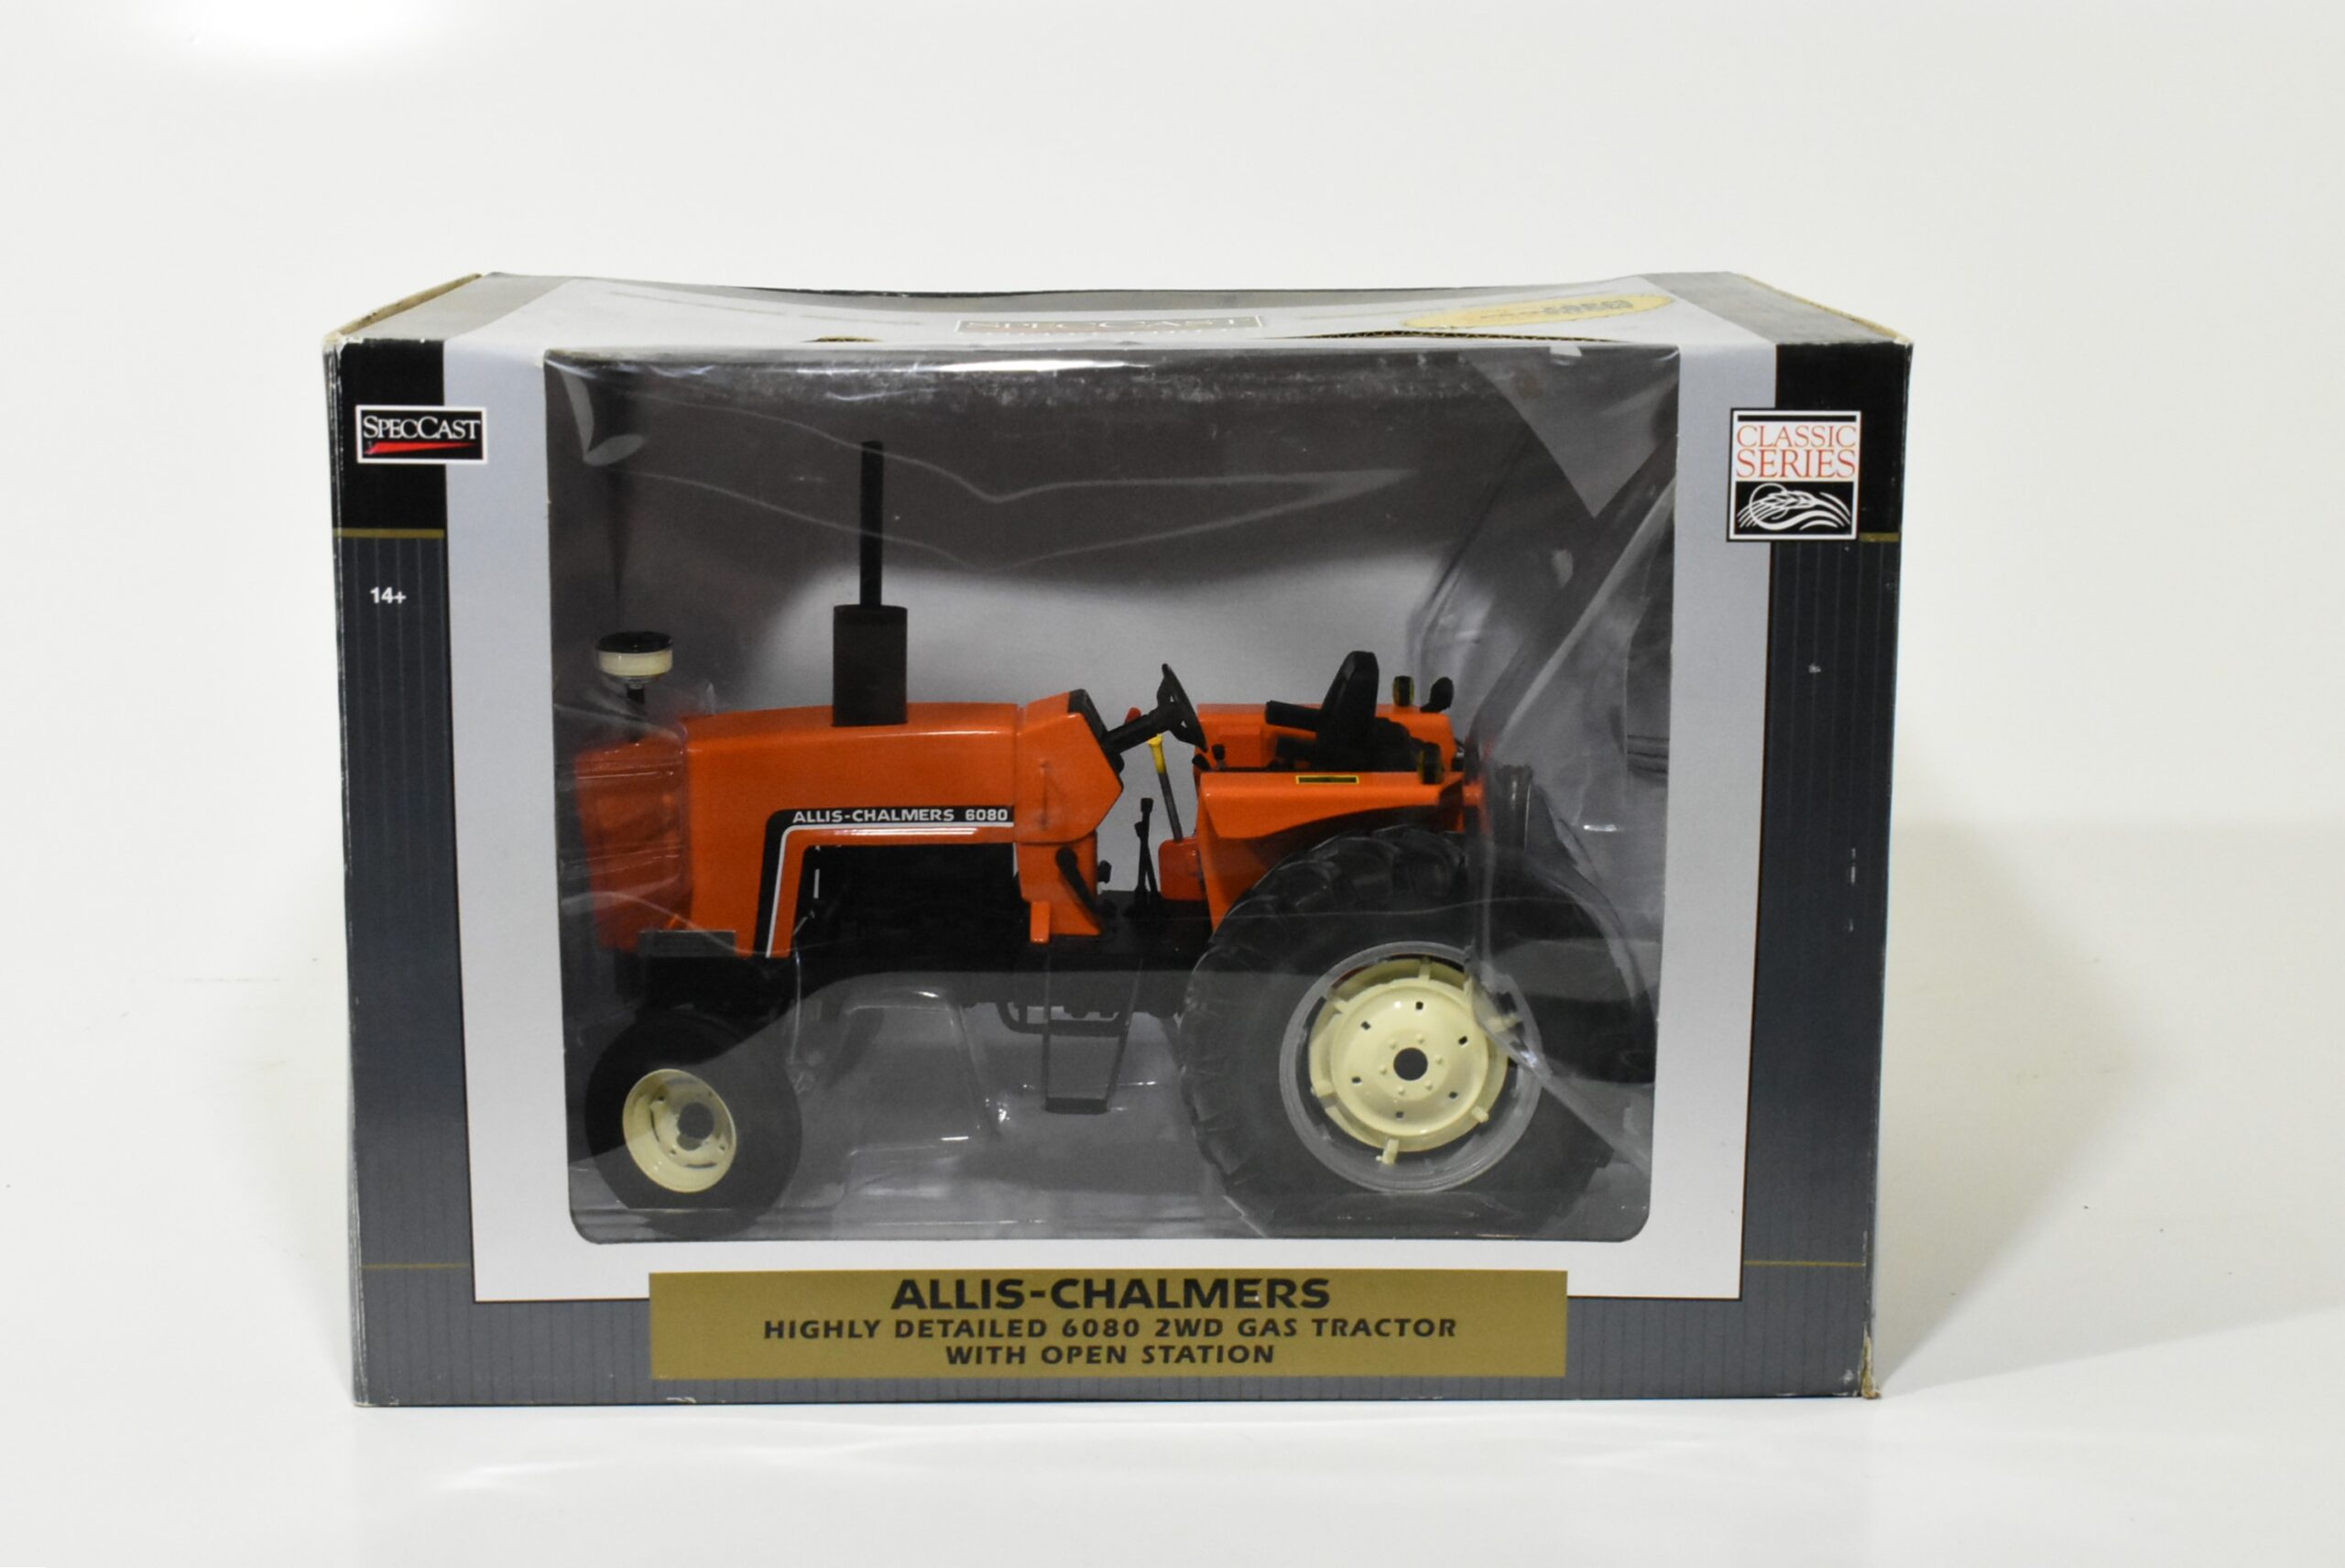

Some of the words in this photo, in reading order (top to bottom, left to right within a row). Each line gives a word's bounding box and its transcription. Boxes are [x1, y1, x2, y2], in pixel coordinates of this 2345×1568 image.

[1737, 424, 1857, 448] CLASSIC
[1736, 448, 1856, 478] SERIES
[369, 586, 407, 604] 14+
[792, 809, 954, 823] ALLIS-CHALMERS
[965, 809, 1008, 822] 6080
[890, 1278, 1330, 1310] ALLIS-CHALMERS
[764, 1320, 881, 1339] HIGHLY
[894, 1319, 1047, 1338] DETAILED
[1062, 1318, 1140, 1338] 6080
[1154, 1318, 1223, 1337] 2WD
[1238, 1318, 1297, 1337] GAS
[1312, 1318, 1456, 1337] TRACTOR
[945, 1345, 1026, 1365] WITH
[1041, 1345, 1127, 1364] OPEN
[1141, 1345, 1275, 1364] STATION
